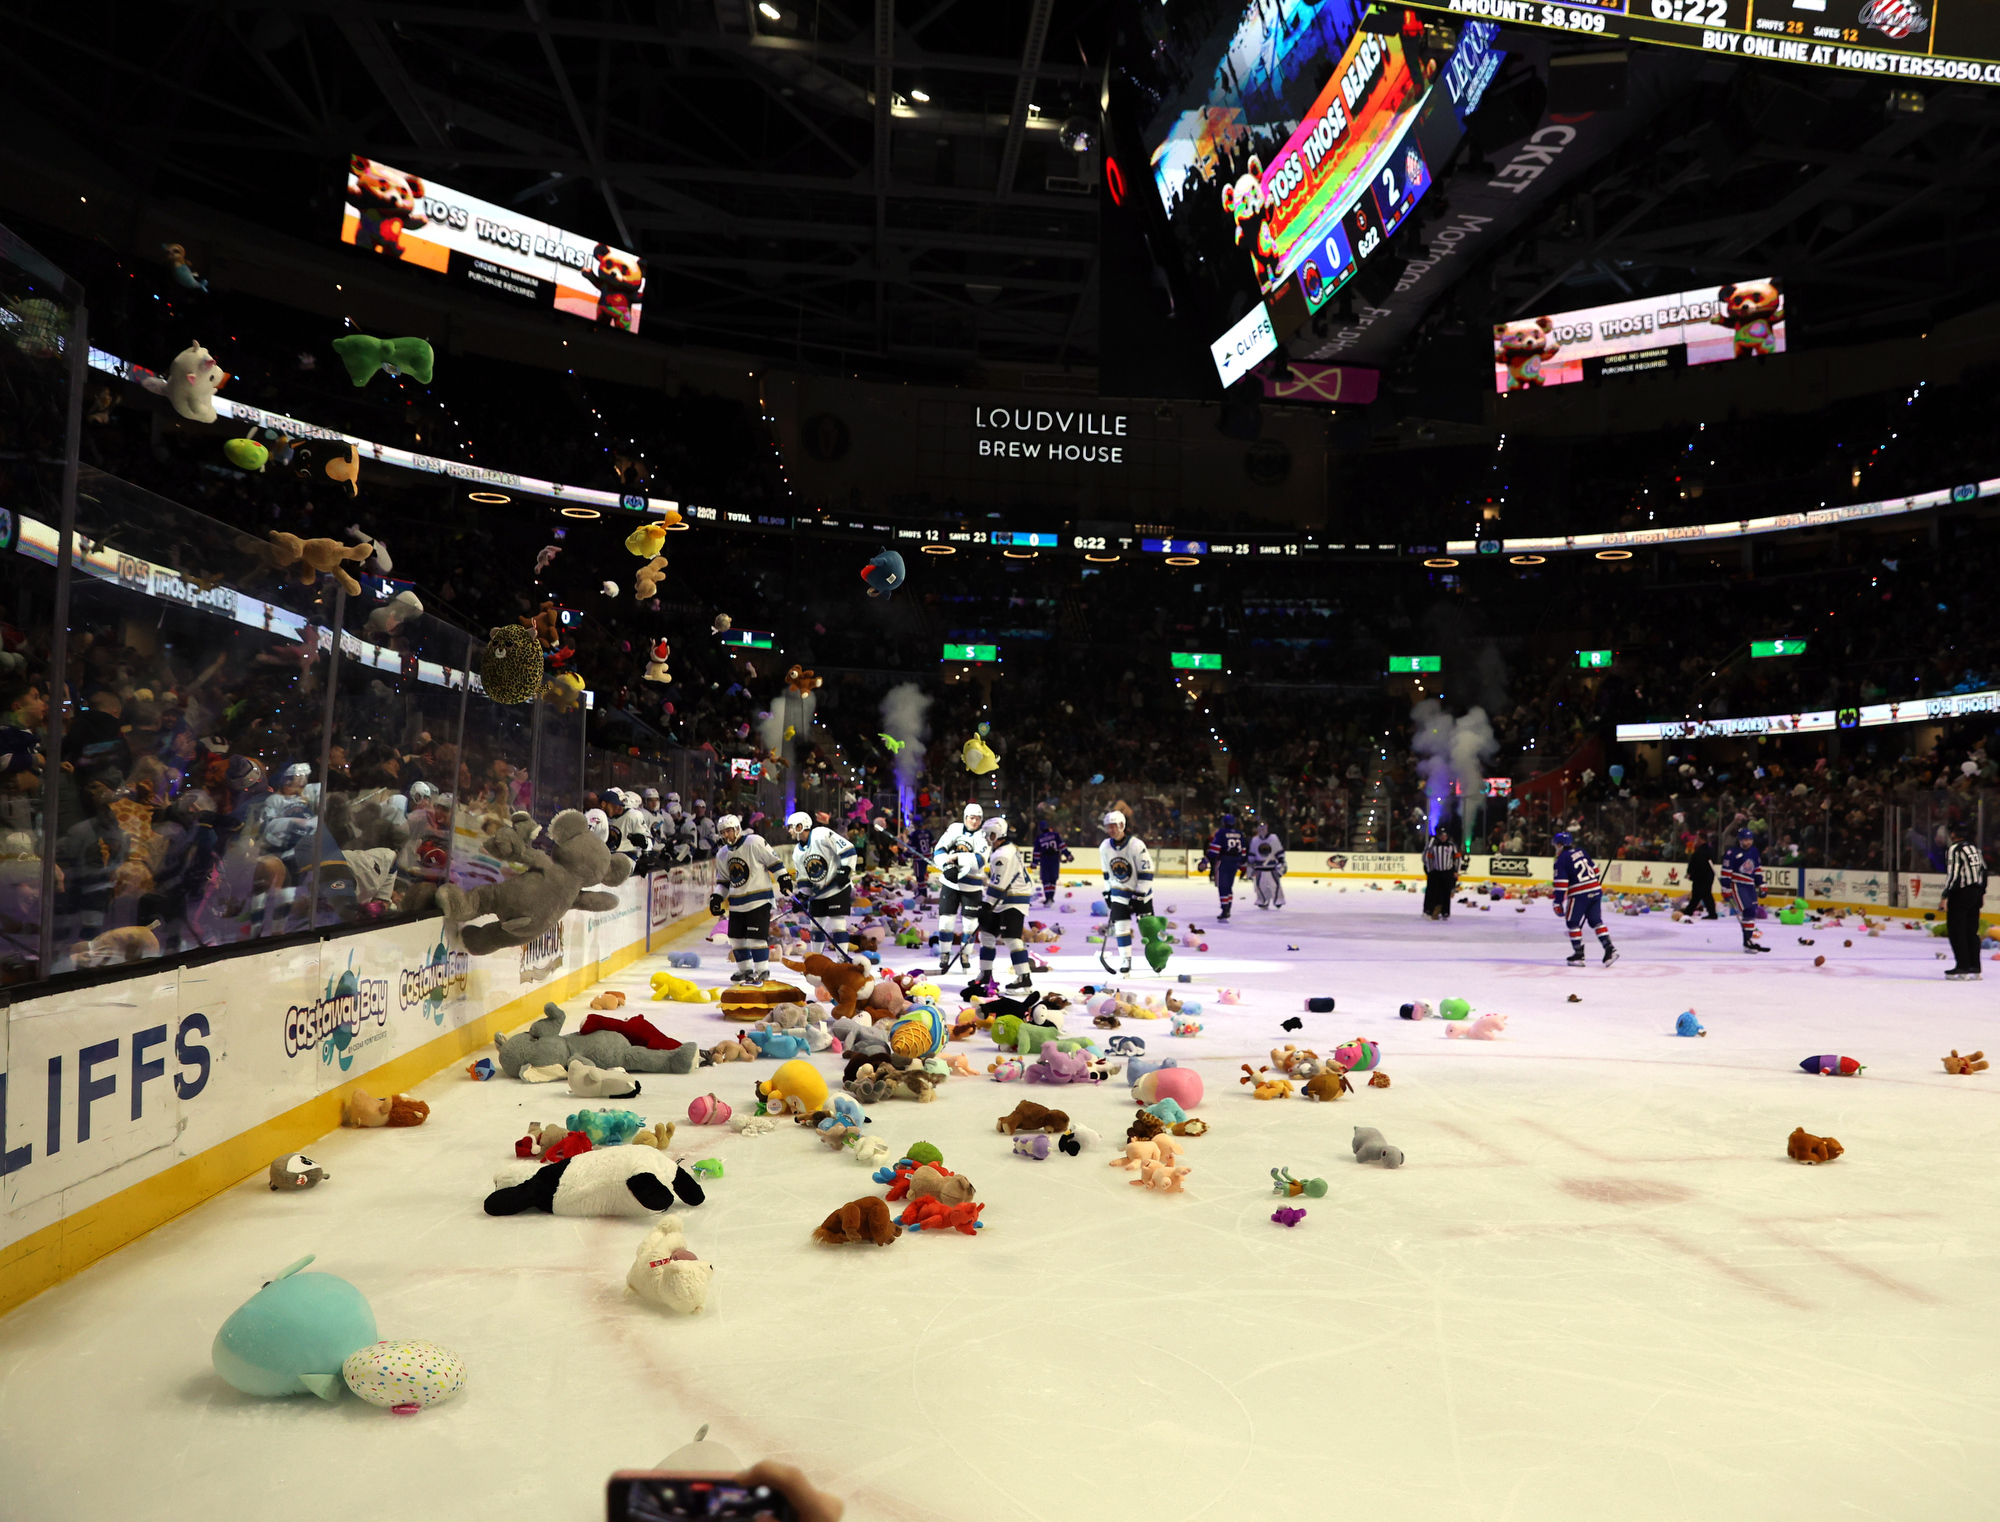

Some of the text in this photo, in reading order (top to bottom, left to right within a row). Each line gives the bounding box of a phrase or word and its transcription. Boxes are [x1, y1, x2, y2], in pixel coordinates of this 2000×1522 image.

[1448, 0, 1605, 32] AMOUNT: $8,909
[1651, 0, 1727, 27] 6:22
[1756, 18, 1784, 32] SHOTS
[1813, 26, 1859, 42] SAVES 12
[1702, 30, 1741, 50] BUY
[1742, 36, 1808, 62] ONLINE
[1810, 45, 1836, 64] AT
[1268, 150, 1304, 207] TOSS
[1302, 95, 1347, 169] THOSE
[1383, 167, 1401, 207] 2
[422, 197, 469, 231] TOSS
[476, 217, 532, 254] THOSE
[1358, 226, 1381, 259] 6:22
[1325, 236, 1341, 270] 0
[468, 270, 502, 289] PURCHASE
[1236, 319, 1271, 356] CLIFFS
[1555, 322, 1592, 344] TOSS
[1600, 316, 1653, 338] THOSE
[1601, 364, 1634, 376] PURCHASE
[231, 402, 261, 423] TOSS
[265, 413, 301, 436] THOSE
[976, 406, 1127, 436] LOUDVILLE
[979, 439, 1123, 463] BREW HOUSE
[412, 454, 440, 472] TOSS
[446, 464, 480, 480] THOSE
[727, 512, 752, 524] TOTAL
[899, 530, 939, 541] SHOTS 12
[949, 532, 987, 543] SAVES 23
[1029, 533, 1039, 546] 0
[1074, 536, 1106, 550] 6:22
[1161, 539, 1172, 553] 2
[1211, 543, 1250, 555] SHOTS 25
[1259, 546, 1281, 554] SAVES
[1284, 544, 1298, 555] 12
[118, 554, 150, 587] TOSS
[742, 631, 753, 645] N
[965, 646, 975, 658] S
[1773, 640, 1784, 653] S
[1193, 654, 1202, 667] T
[1411, 657, 1420, 670] E
[1590, 652, 1601, 665] R
[1352, 854, 1405, 862] COLUMBUS
[1775, 870, 1790, 886] ICE
[284, 978, 388, 1058] Castaway Bay
